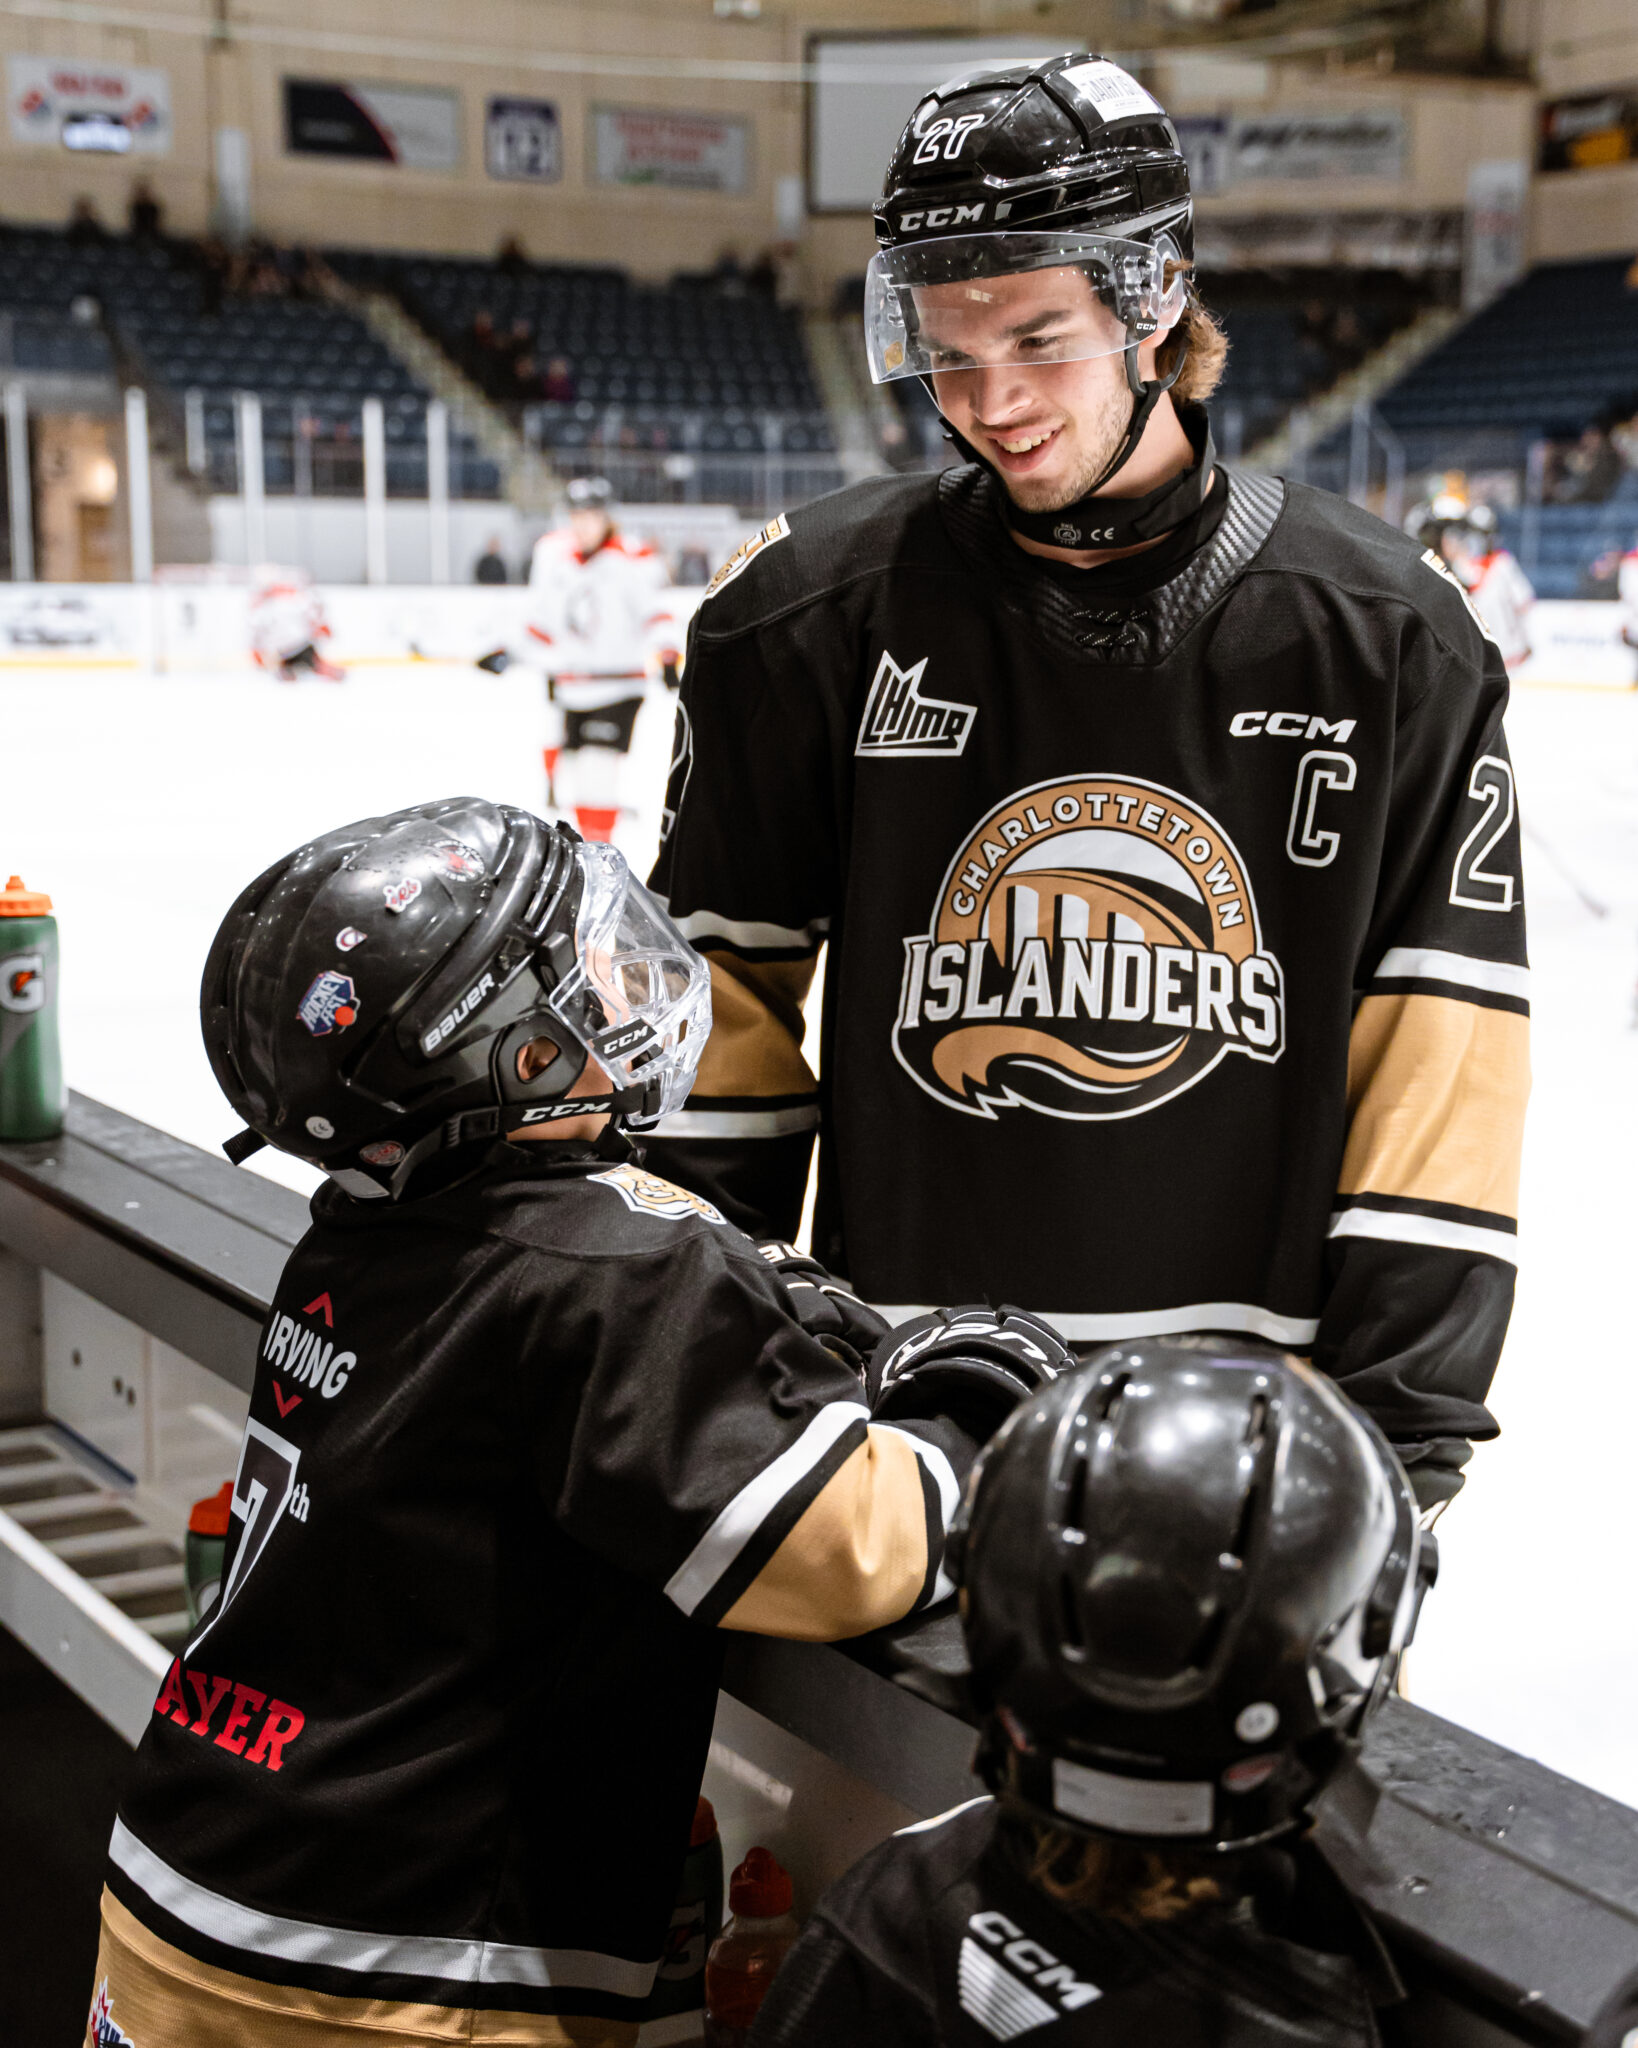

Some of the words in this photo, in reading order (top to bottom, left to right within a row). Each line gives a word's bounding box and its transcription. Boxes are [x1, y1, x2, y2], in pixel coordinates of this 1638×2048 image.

[913, 114, 985, 165] 27
[899, 203, 985, 232] CCM
[1136, 322, 1157, 331] CCM
[1229, 711, 1357, 743] CCM
[1286, 749, 1357, 868] C
[1449, 754, 1515, 912] 2
[952, 793, 1245, 929] CHARLOTTETOWN
[300, 973, 346, 1032] HOCKEY
[901, 937, 1278, 1047] ISLANDERS
[604, 1026, 648, 1054] CCM
[521, 1102, 612, 1122] CCM
[263, 1310, 357, 1399] IRVING
[969, 1911, 1103, 2011] CCM
